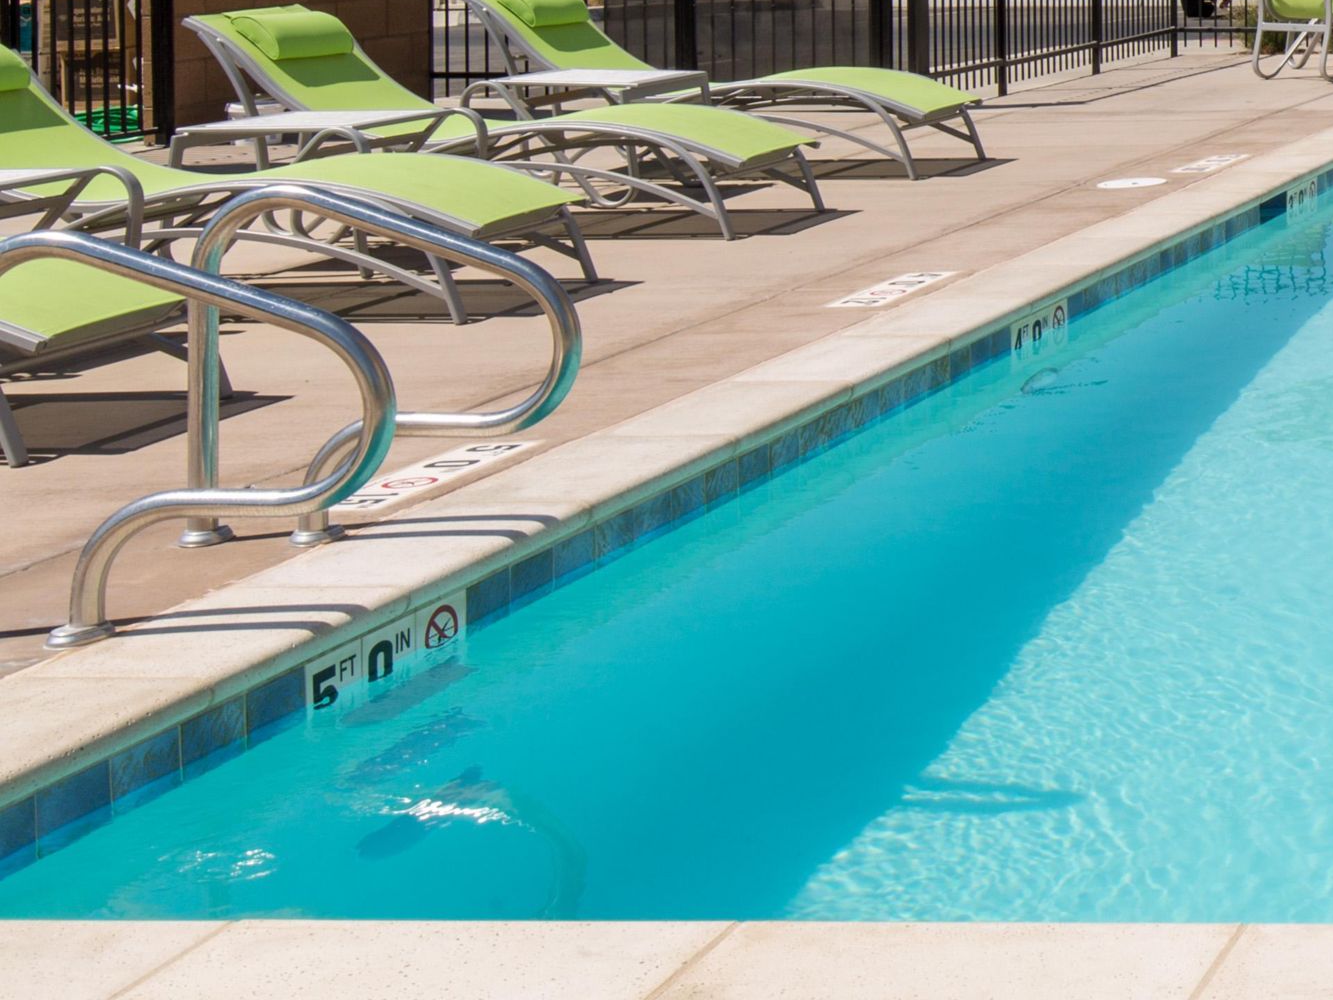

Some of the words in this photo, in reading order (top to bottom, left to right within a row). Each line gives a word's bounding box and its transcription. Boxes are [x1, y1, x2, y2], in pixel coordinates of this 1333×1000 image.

[313, 663, 338, 710] 5
[340, 654, 356, 682] FT
[368, 639, 393, 683] 0
[395, 628, 410, 654] IN
